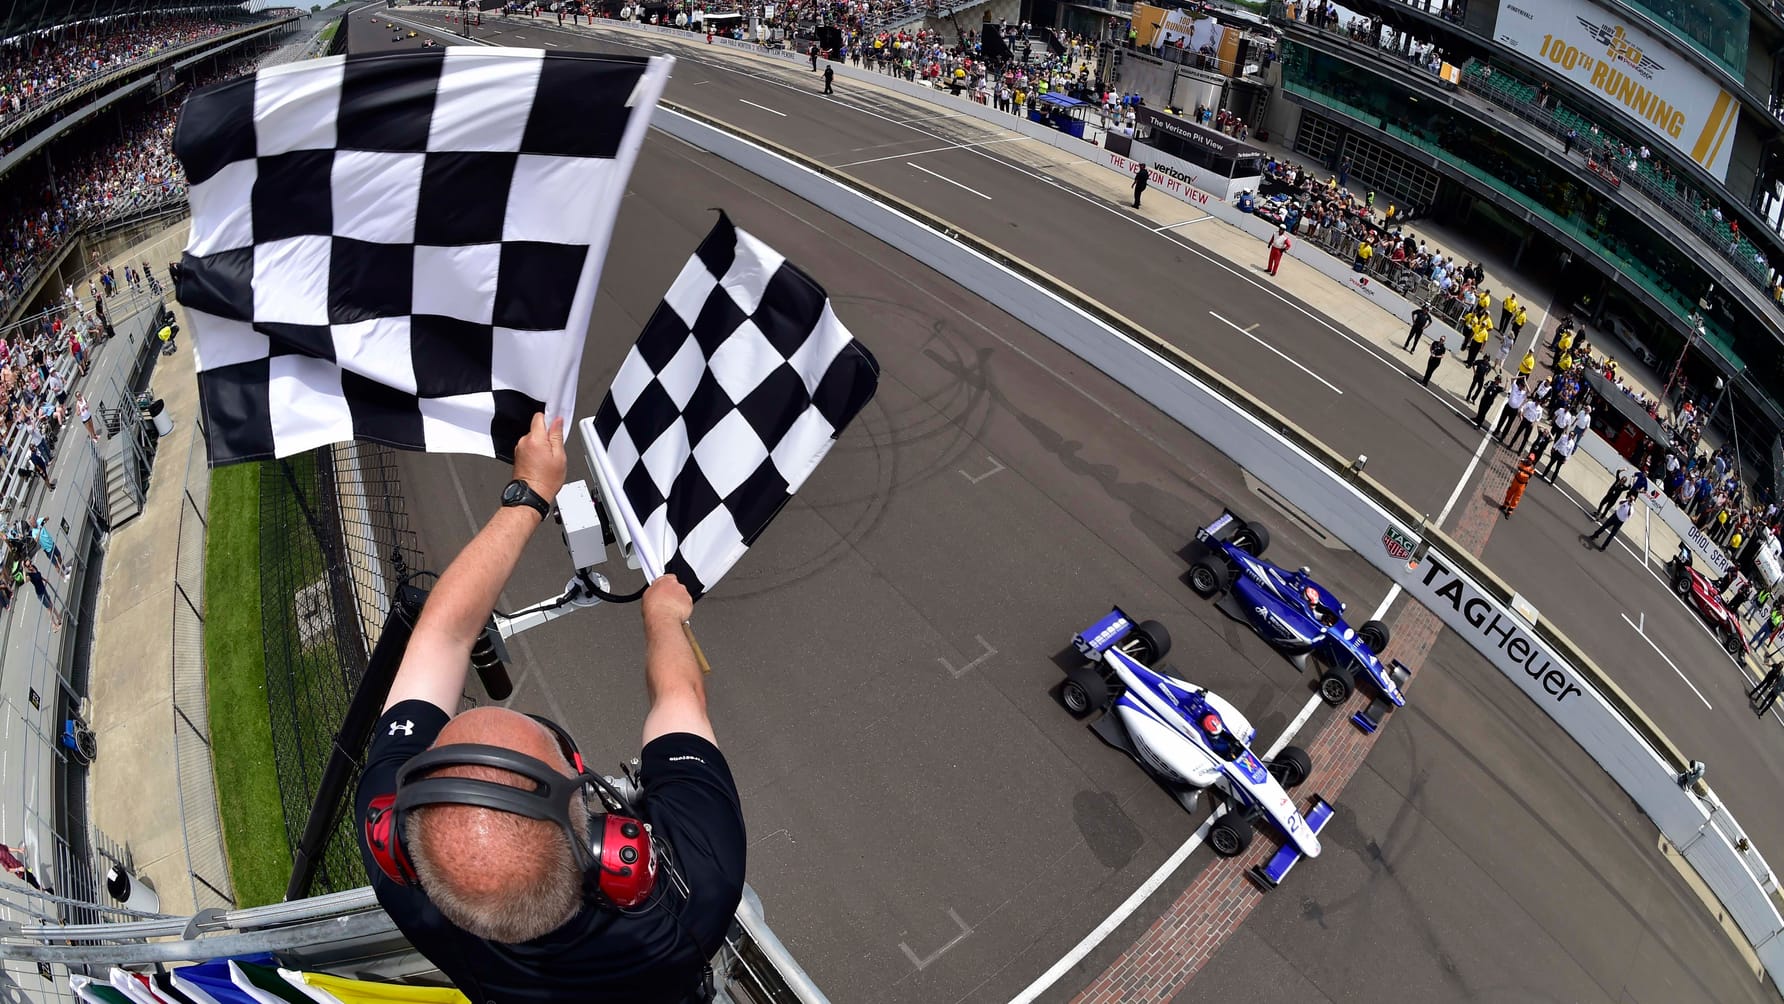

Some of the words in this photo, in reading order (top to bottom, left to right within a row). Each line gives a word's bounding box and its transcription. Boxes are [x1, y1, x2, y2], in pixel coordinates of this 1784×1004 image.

[1165, 21, 1193, 36] RUNNIN
[1539, 34, 1594, 71] 100TH
[1590, 60, 1685, 140] RUNNING
[1150, 116, 1163, 128] The
[1165, 120, 1192, 138] Verizon
[1193, 132, 1204, 144] Pit
[1205, 137, 1224, 151] View
[1110, 154, 1125, 169] THE
[1129, 162, 1163, 186] VEZON
[1167, 178, 1182, 193] PIT
[1184, 185, 1209, 205] VIEW
[1154, 162, 1192, 184] verizon
[1383, 535, 1408, 560] HEUER
[1389, 528, 1413, 550] TAG
[1688, 526, 1710, 554] ORIOL
[1710, 549, 1731, 573] SERV
[1073, 635, 1093, 654] 27
[1287, 808, 1303, 833] 27
